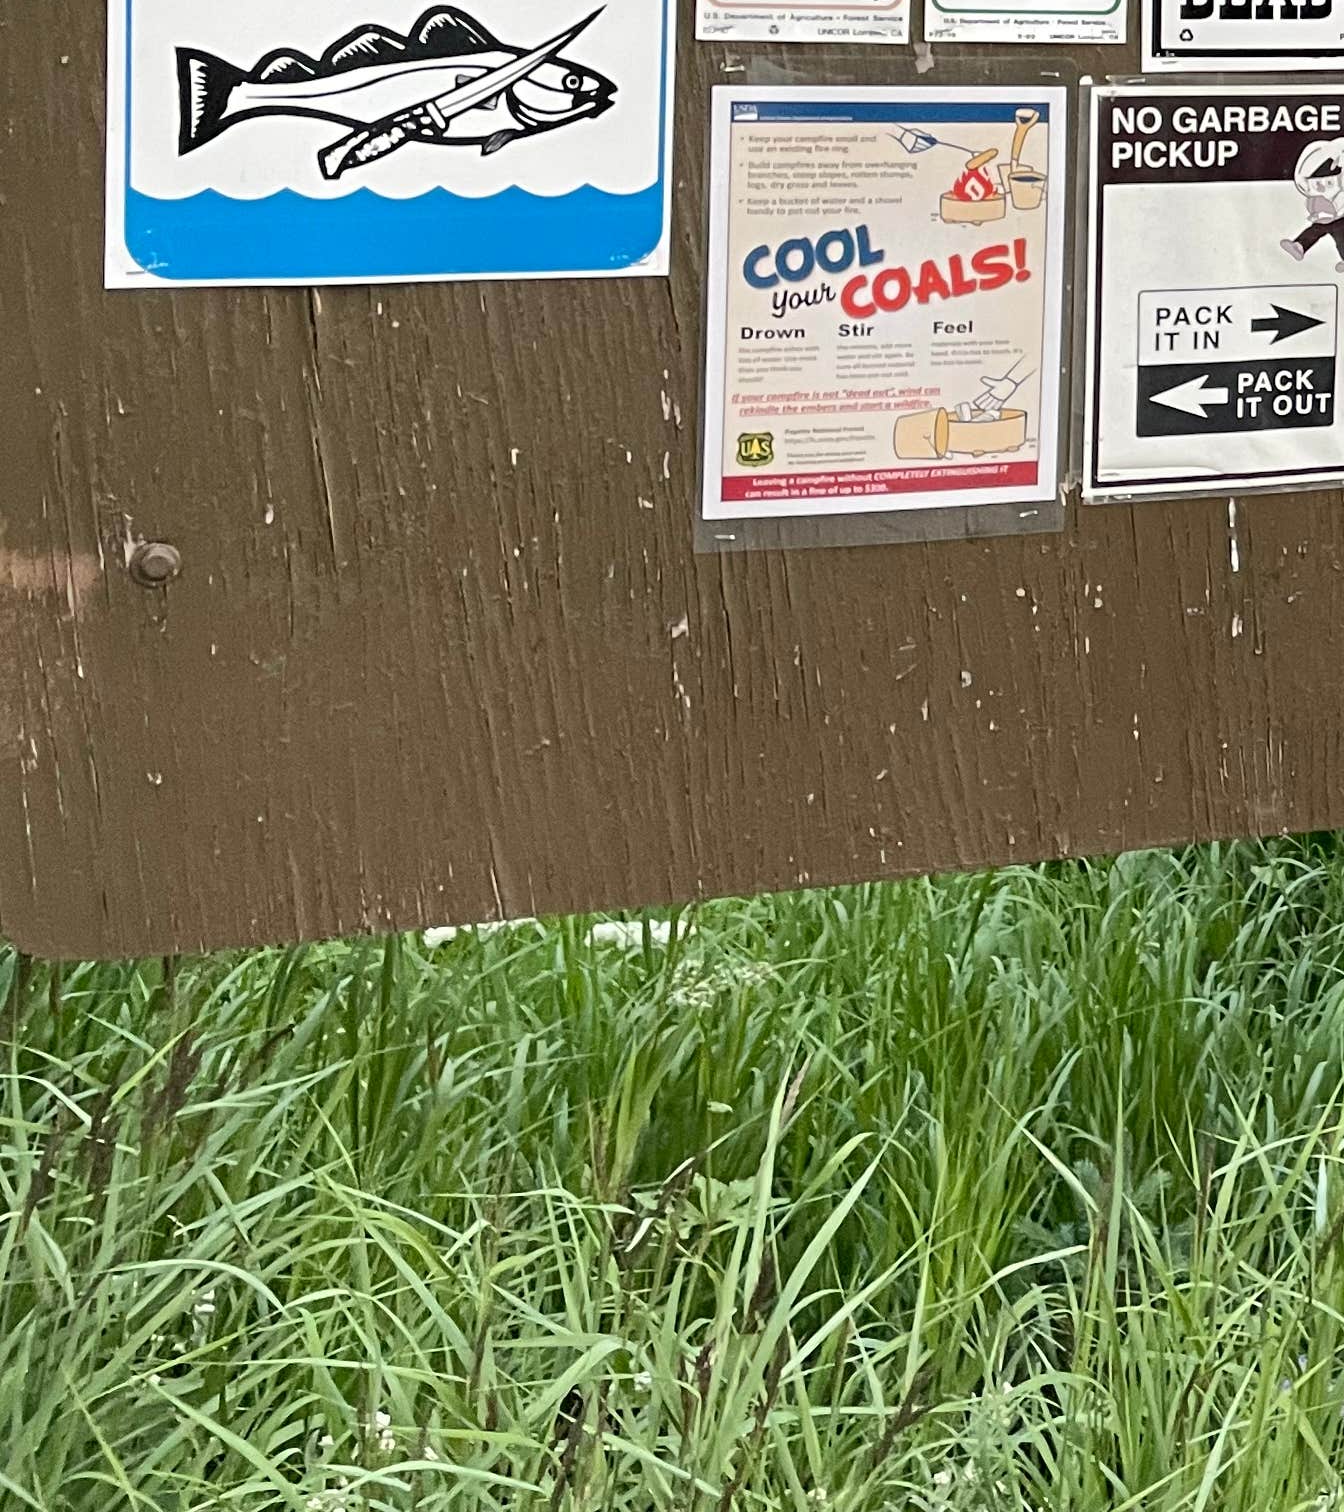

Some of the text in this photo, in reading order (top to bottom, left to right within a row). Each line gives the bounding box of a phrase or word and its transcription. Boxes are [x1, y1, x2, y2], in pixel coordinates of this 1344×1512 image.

[1113, 105, 1340, 134] NO GARBAGE
[1112, 141, 1238, 168] PICKUP
[742, 225, 884, 288] COOL
[772, 238, 1031, 319] your COALS!
[1157, 306, 1232, 325] PACK
[741, 321, 972, 339] Drown Stir Feel
[1156, 331, 1219, 351] IT IN
[1238, 370, 1313, 393] PACK
[1237, 393, 1331, 418] IT OUT
